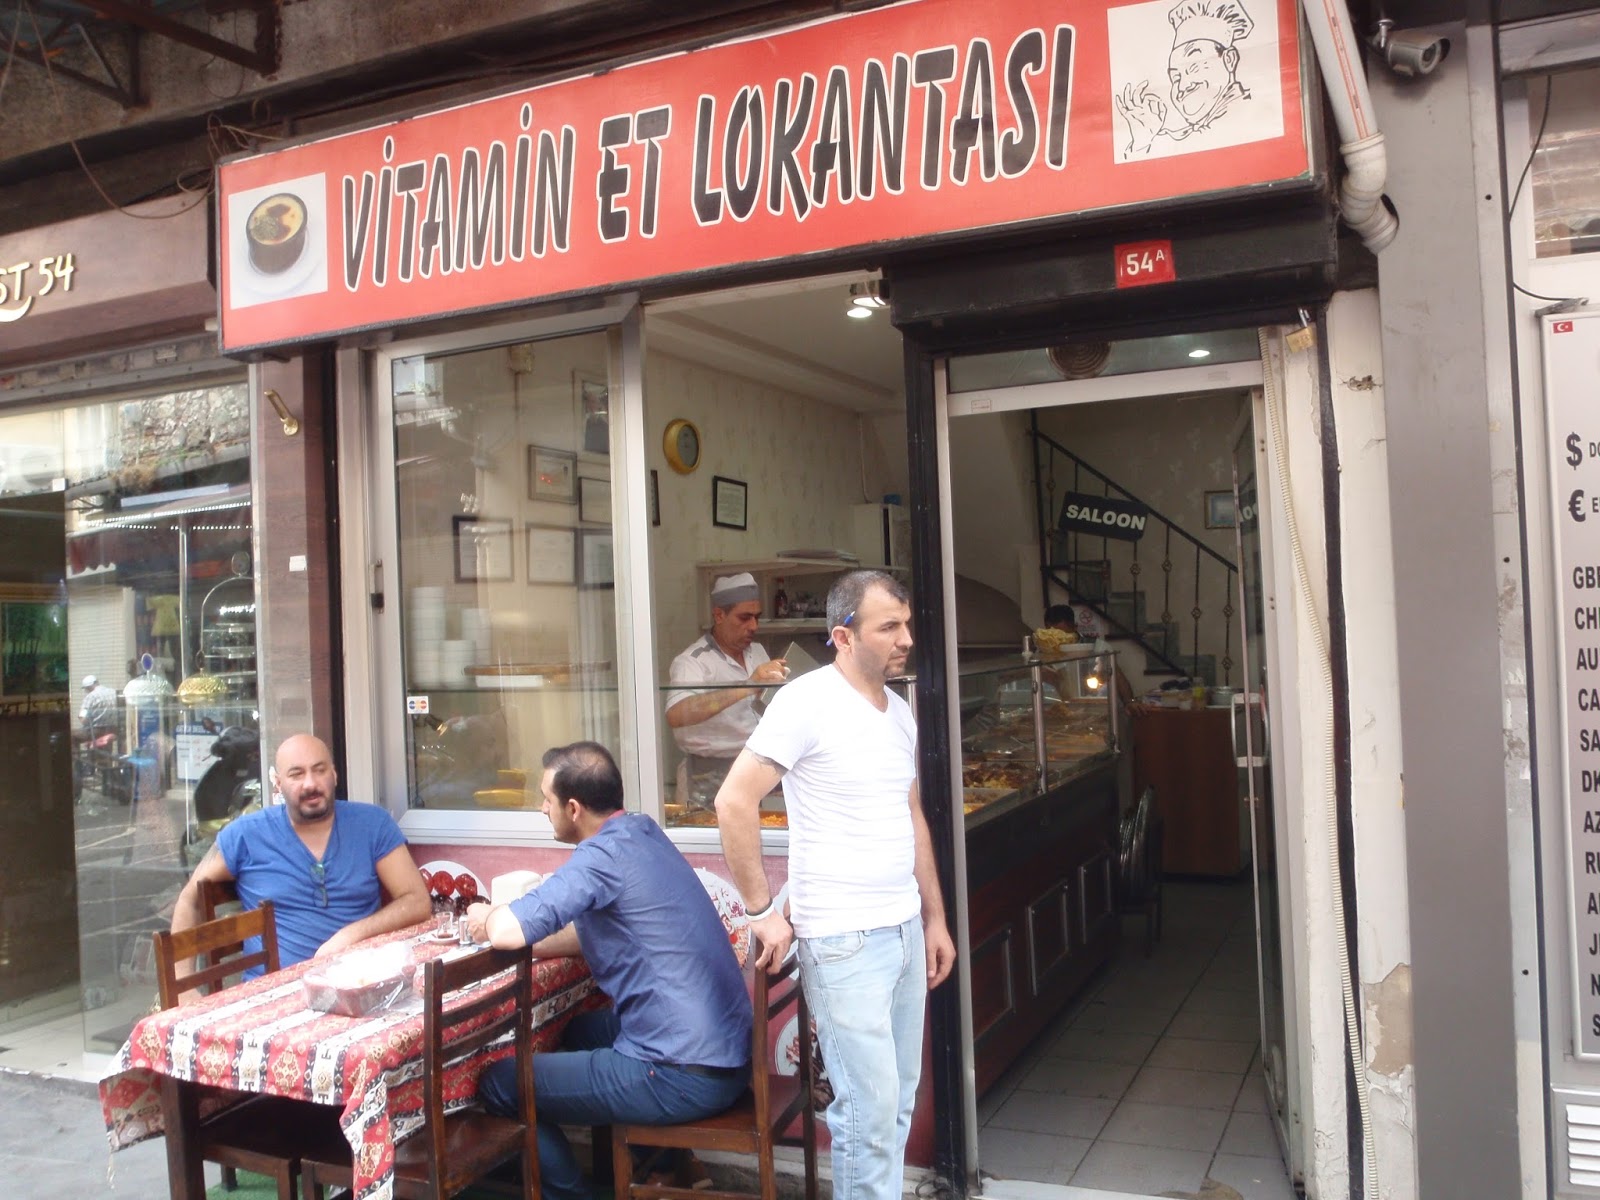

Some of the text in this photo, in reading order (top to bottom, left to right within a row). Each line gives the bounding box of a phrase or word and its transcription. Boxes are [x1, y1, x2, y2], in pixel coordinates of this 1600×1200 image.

[597, 104, 672, 243] ET
[692, 24, 1075, 226] LOKANTASI
[38, 253, 74, 296] 54
[1066, 504, 1146, 531] SALOON
[1574, 607, 1600, 630] CH
[1578, 688, 1600, 711] CA
[1580, 729, 1600, 752] SA
